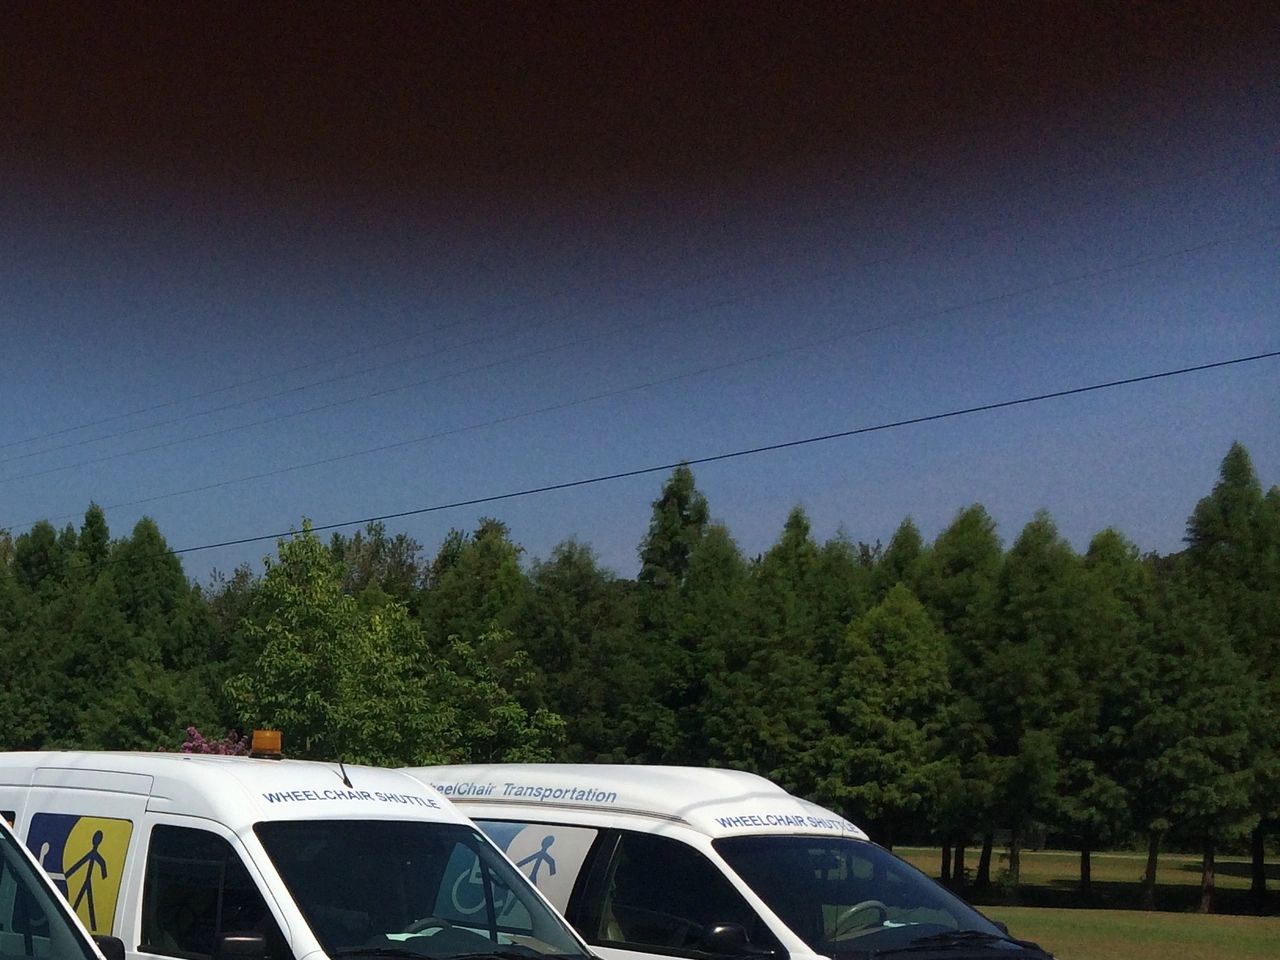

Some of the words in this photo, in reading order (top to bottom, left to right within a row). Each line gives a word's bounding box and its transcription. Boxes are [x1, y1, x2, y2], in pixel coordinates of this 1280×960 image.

[262, 790, 374, 804] WHEELCHAIR
[375, 792, 441, 809] SHUTTLE
[430, 782, 496, 796] eelChair
[503, 782, 617, 803] Transportation
[715, 814, 806, 829] WHEELCHAIR
[807, 816, 860, 834] SHUTTLE
